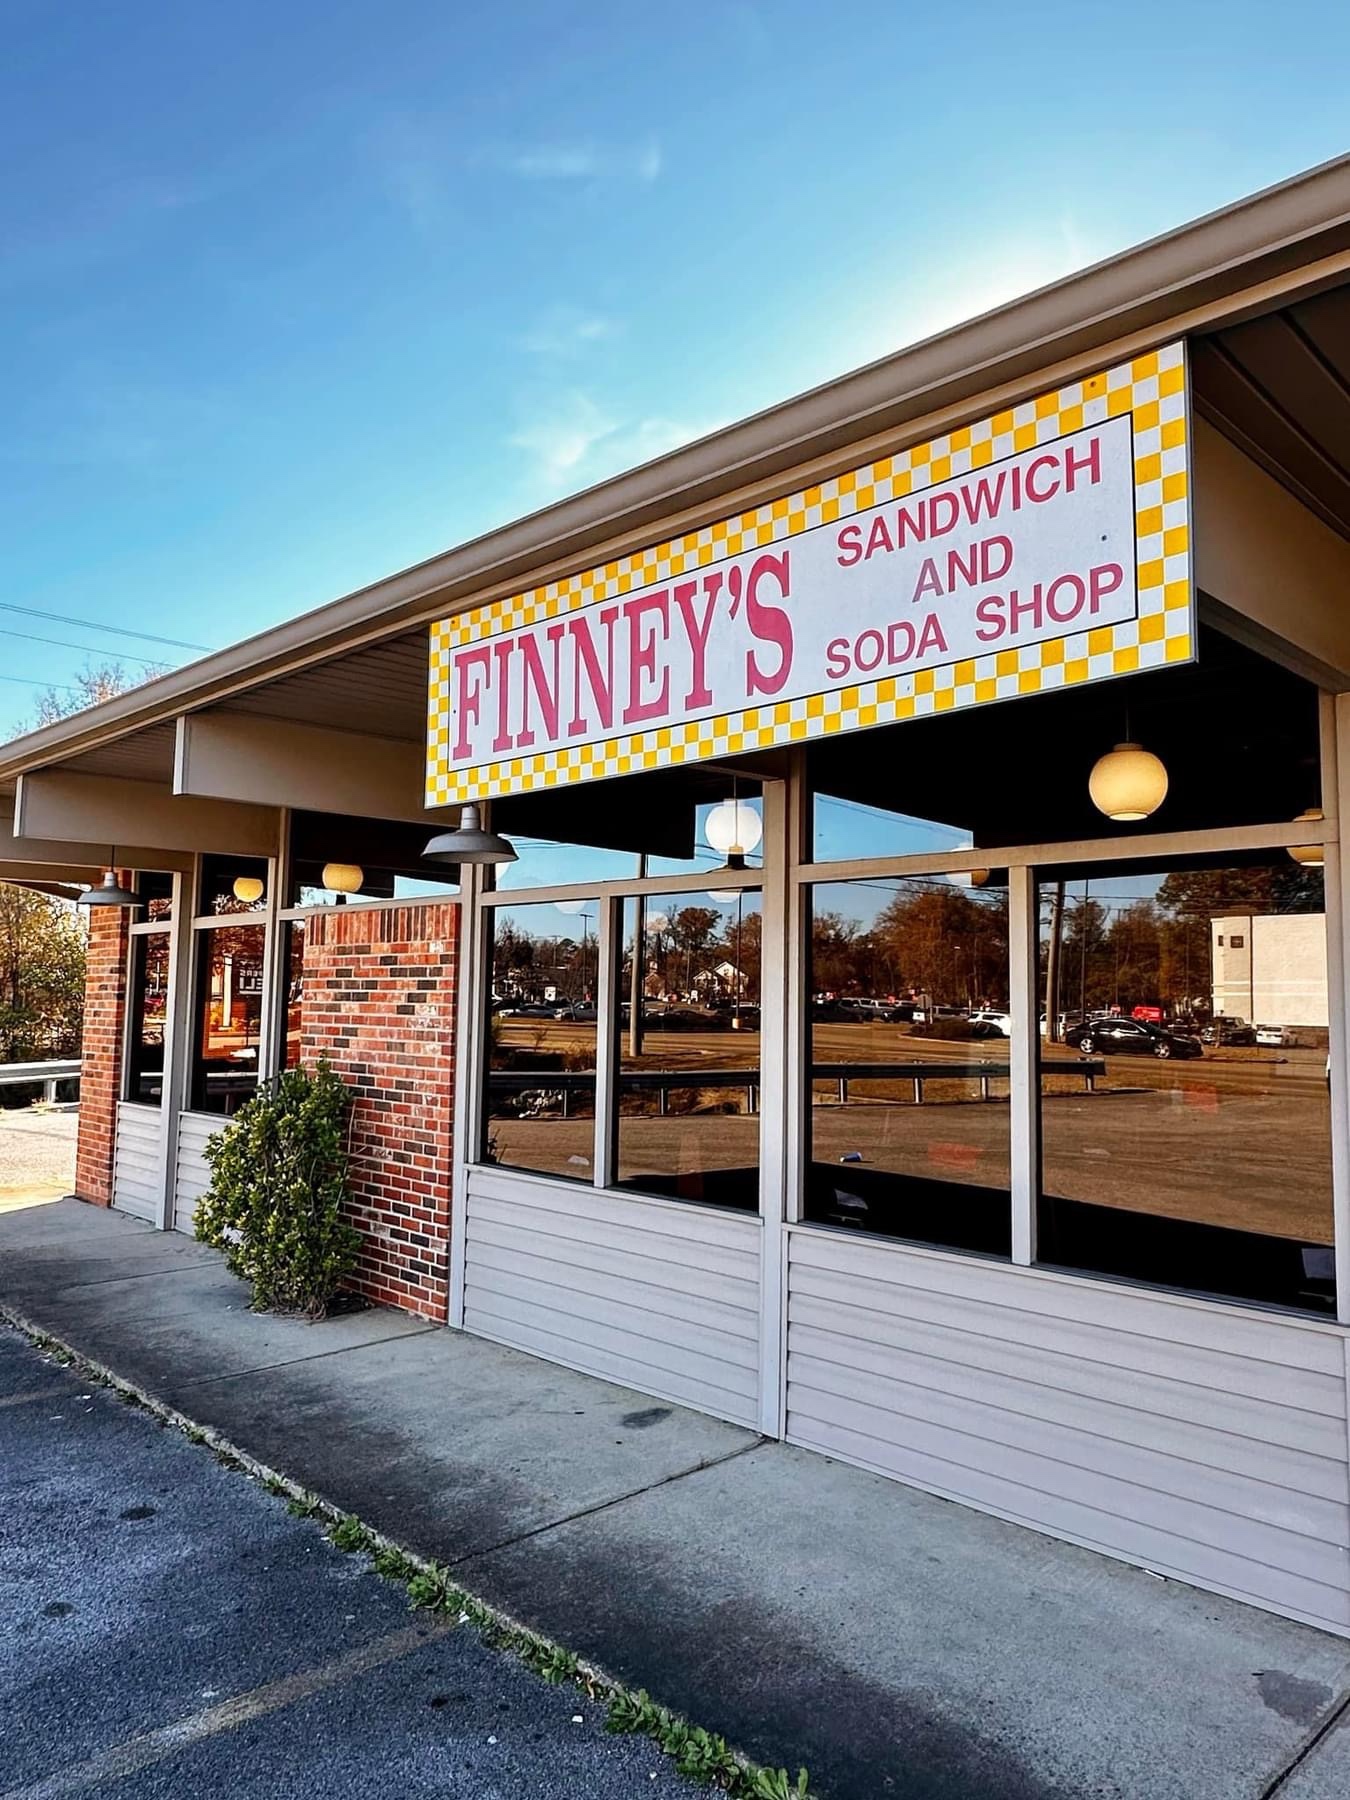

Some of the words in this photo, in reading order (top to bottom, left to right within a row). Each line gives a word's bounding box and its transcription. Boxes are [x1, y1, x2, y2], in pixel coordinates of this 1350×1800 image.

[836, 437, 1101, 567] SANDWICH
[826, 613, 946, 678] SODA
[976, 563, 1124, 641] SHOP
[913, 535, 1013, 603] AND
[452, 550, 794, 761] FINNEY'S
